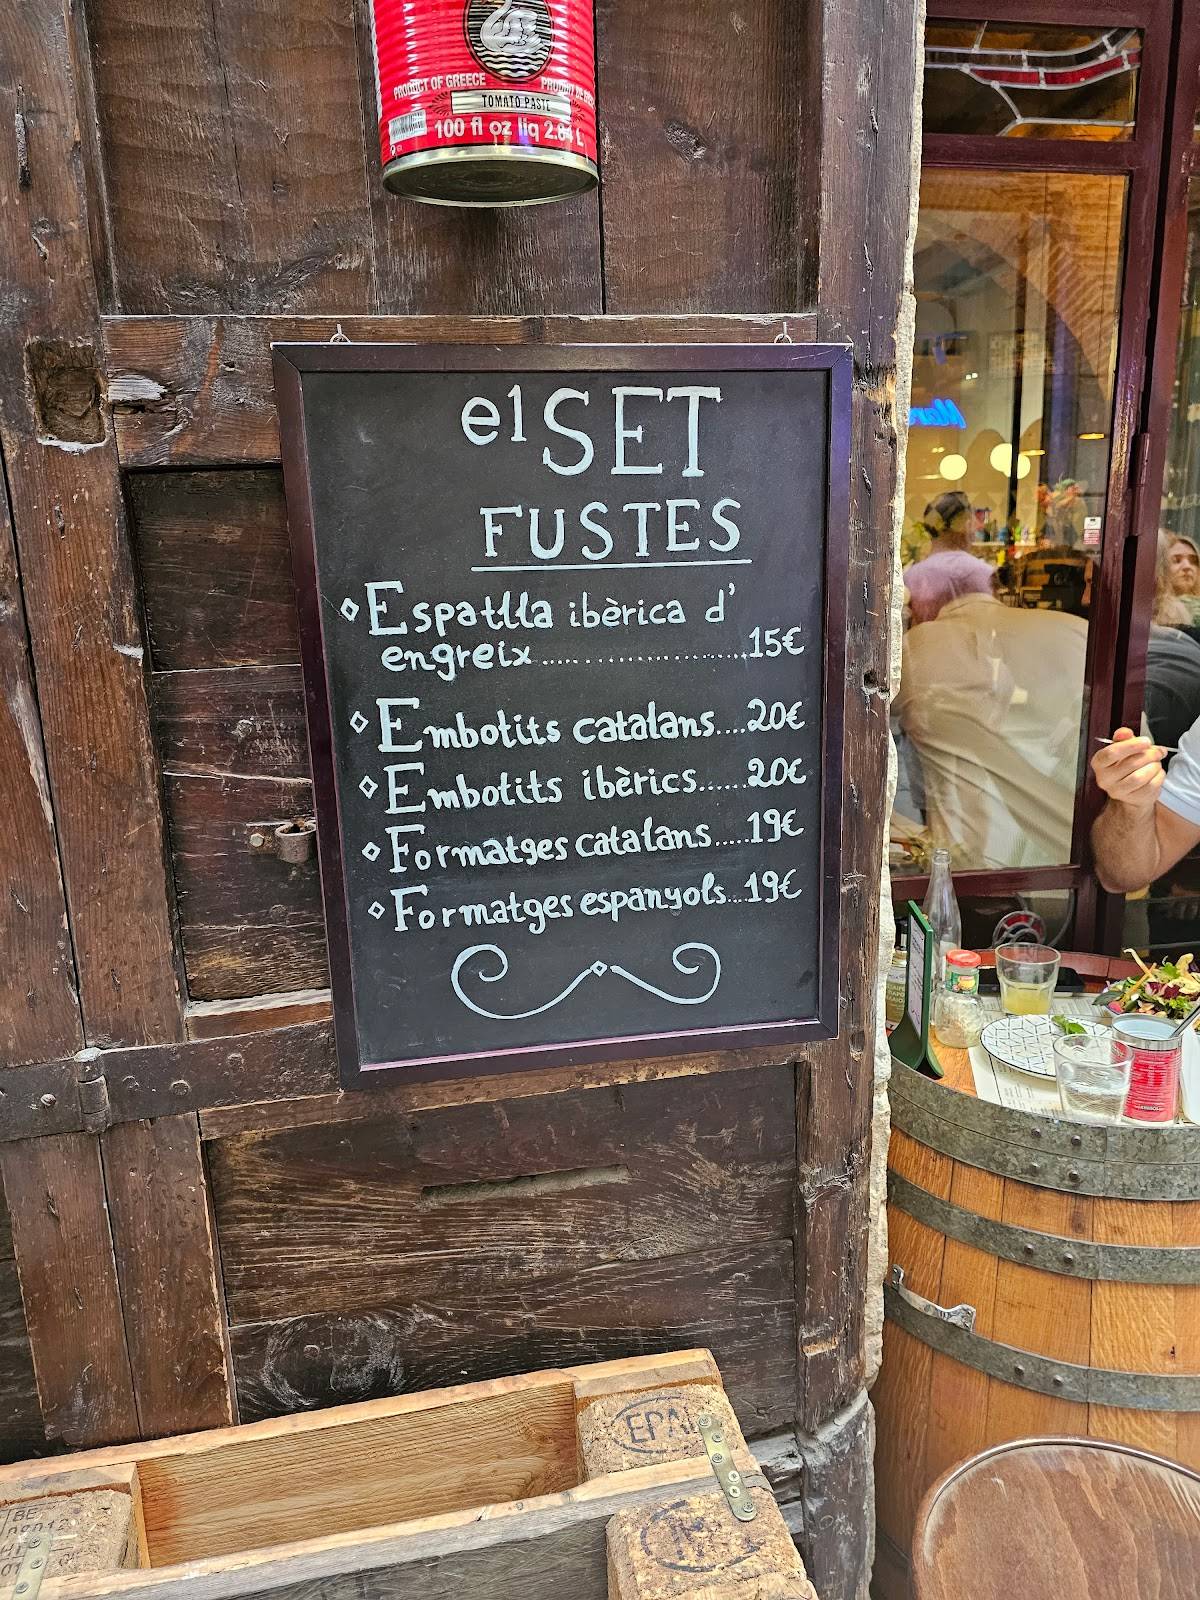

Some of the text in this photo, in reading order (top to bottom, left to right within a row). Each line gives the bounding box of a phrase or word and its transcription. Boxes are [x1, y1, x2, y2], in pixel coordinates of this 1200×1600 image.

[430, 76, 444, 89] OF
[446, 73, 486, 87] GREECE
[481, 94, 551, 112] TOMATO PASTE
[434, 118, 464, 140] 100
[470, 116, 483, 136] fl
[489, 121, 512, 137] oz
[518, 117, 540, 142] liq
[543, 386, 723, 477] SET
[480, 498, 741, 560] FUSTES
[365, 581, 735, 637] Espatlla ibèrica d'
[749, 626, 805, 658] 15€
[376, 697, 805, 752] Embotits catalans 20€
[383, 757, 807, 814] Embotits ibèrics 20€
[384, 808, 805, 873] Formatges catalans 19€
[390, 869, 802, 935] Formatges espanyols 19€
